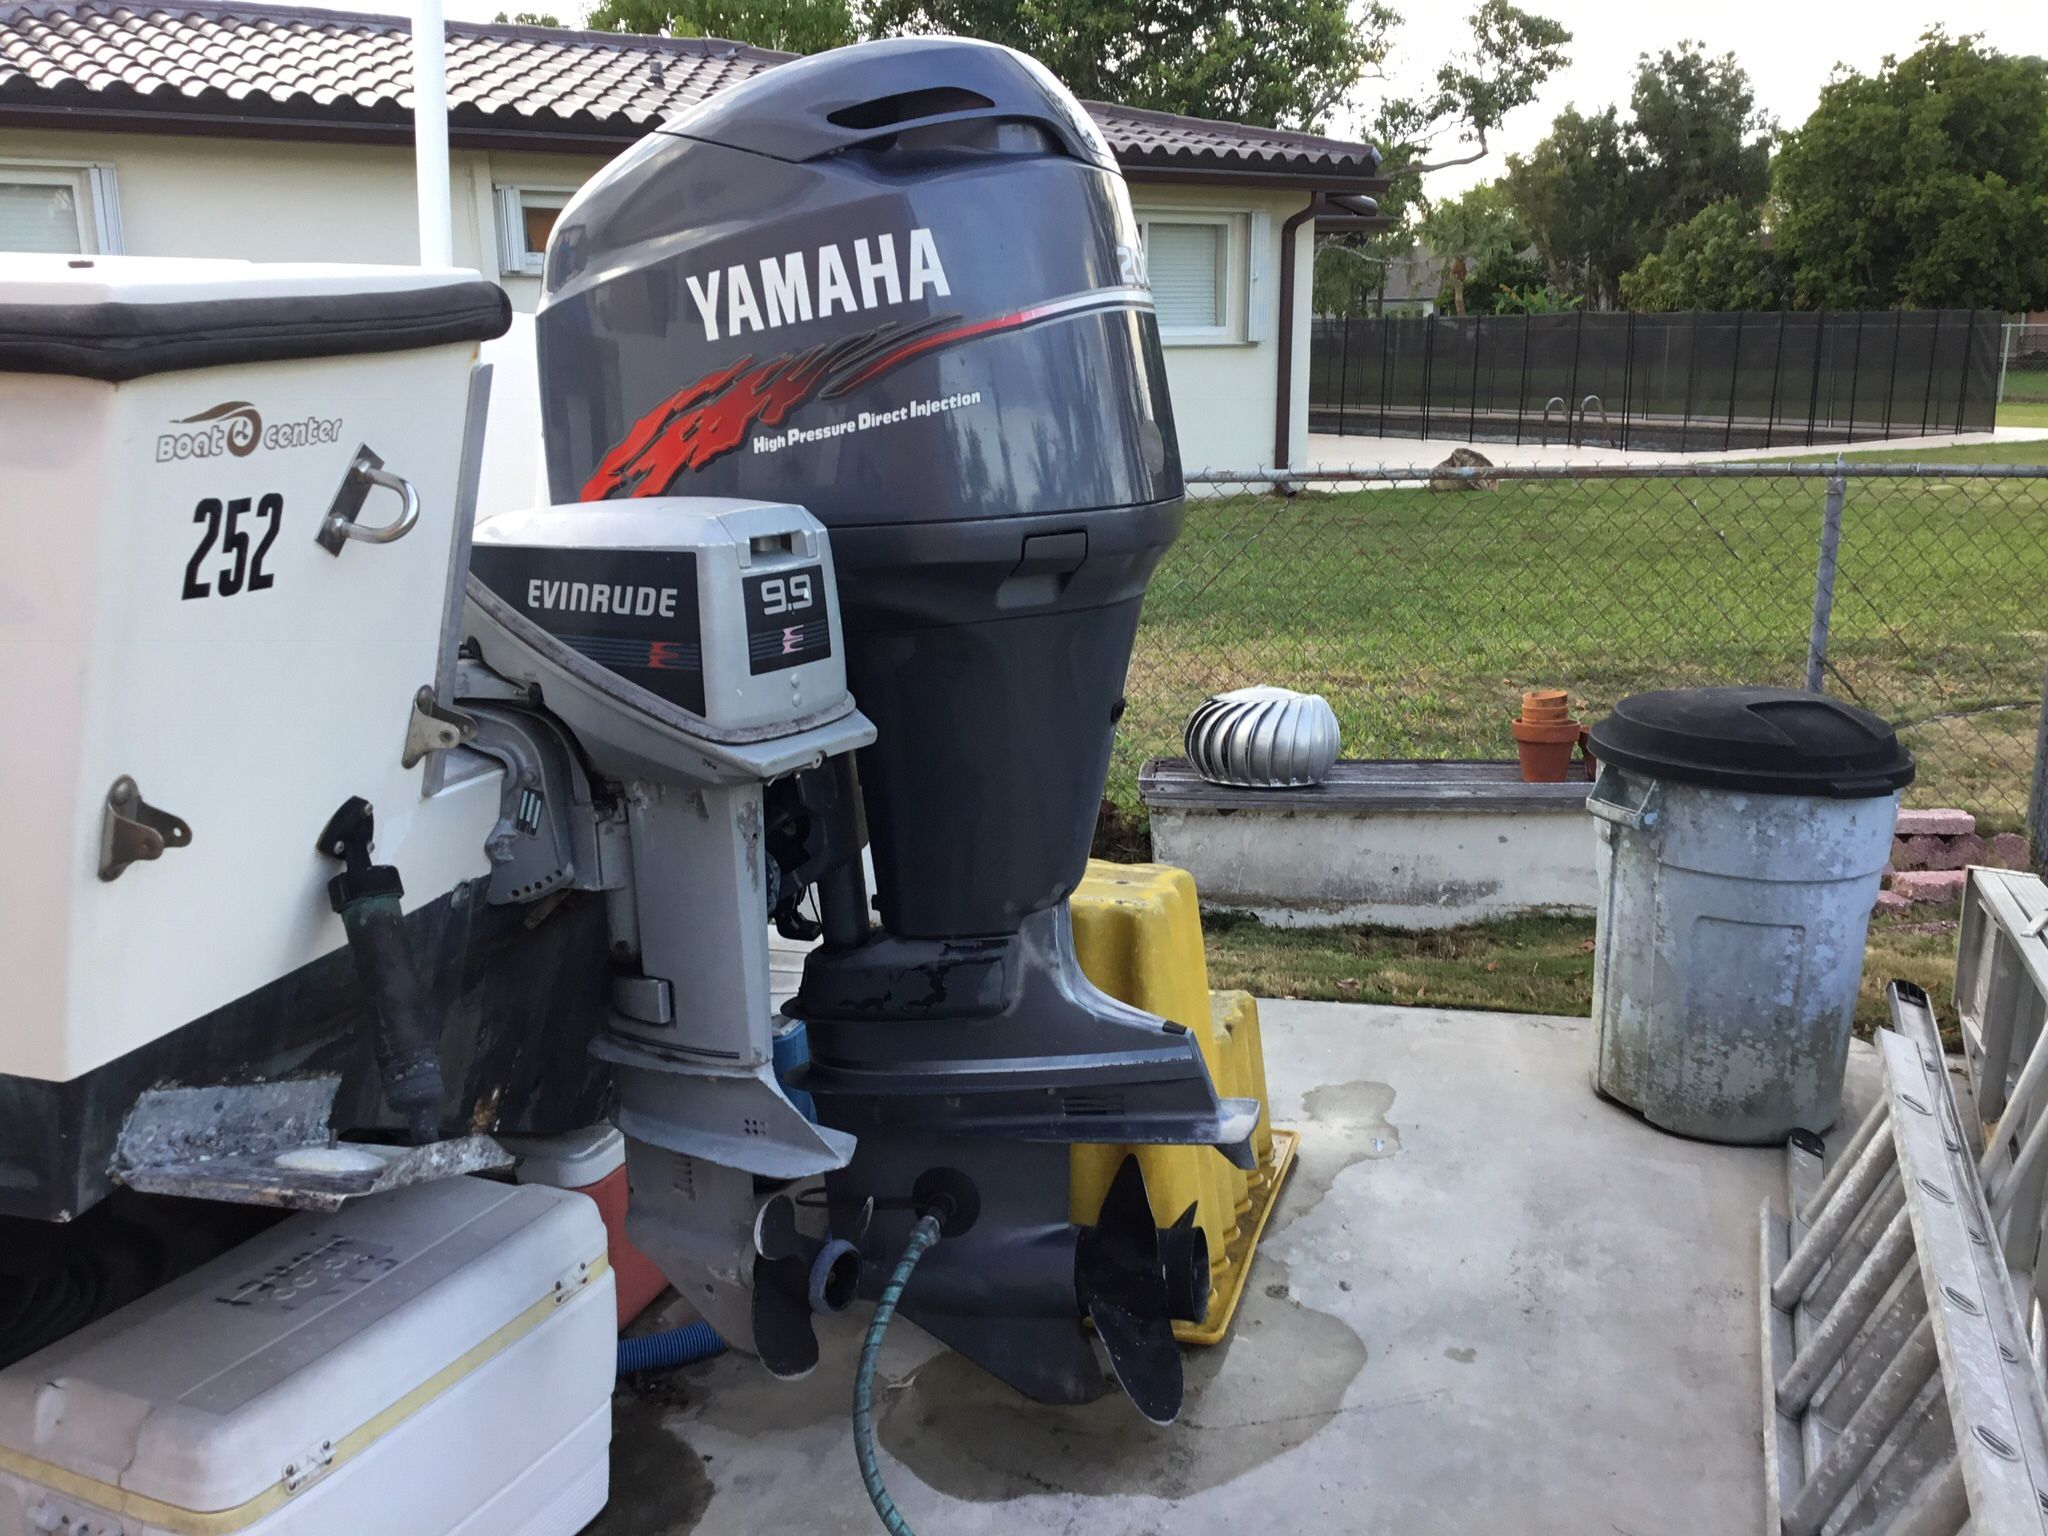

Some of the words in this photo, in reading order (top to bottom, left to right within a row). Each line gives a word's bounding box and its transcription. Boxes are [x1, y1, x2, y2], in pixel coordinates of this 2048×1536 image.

[685, 228, 951, 341] YAMAHA
[156, 425, 225, 463] Boat
[263, 416, 342, 450] center
[753, 434, 786, 454] High
[787, 419, 856, 446] Pressure
[858, 406, 908, 431] Direct
[910, 391, 981, 419] Injection
[181, 492, 284, 601] 252
[527, 578, 678, 618] EVINRUDE
[760, 573, 813, 615] 9.9
